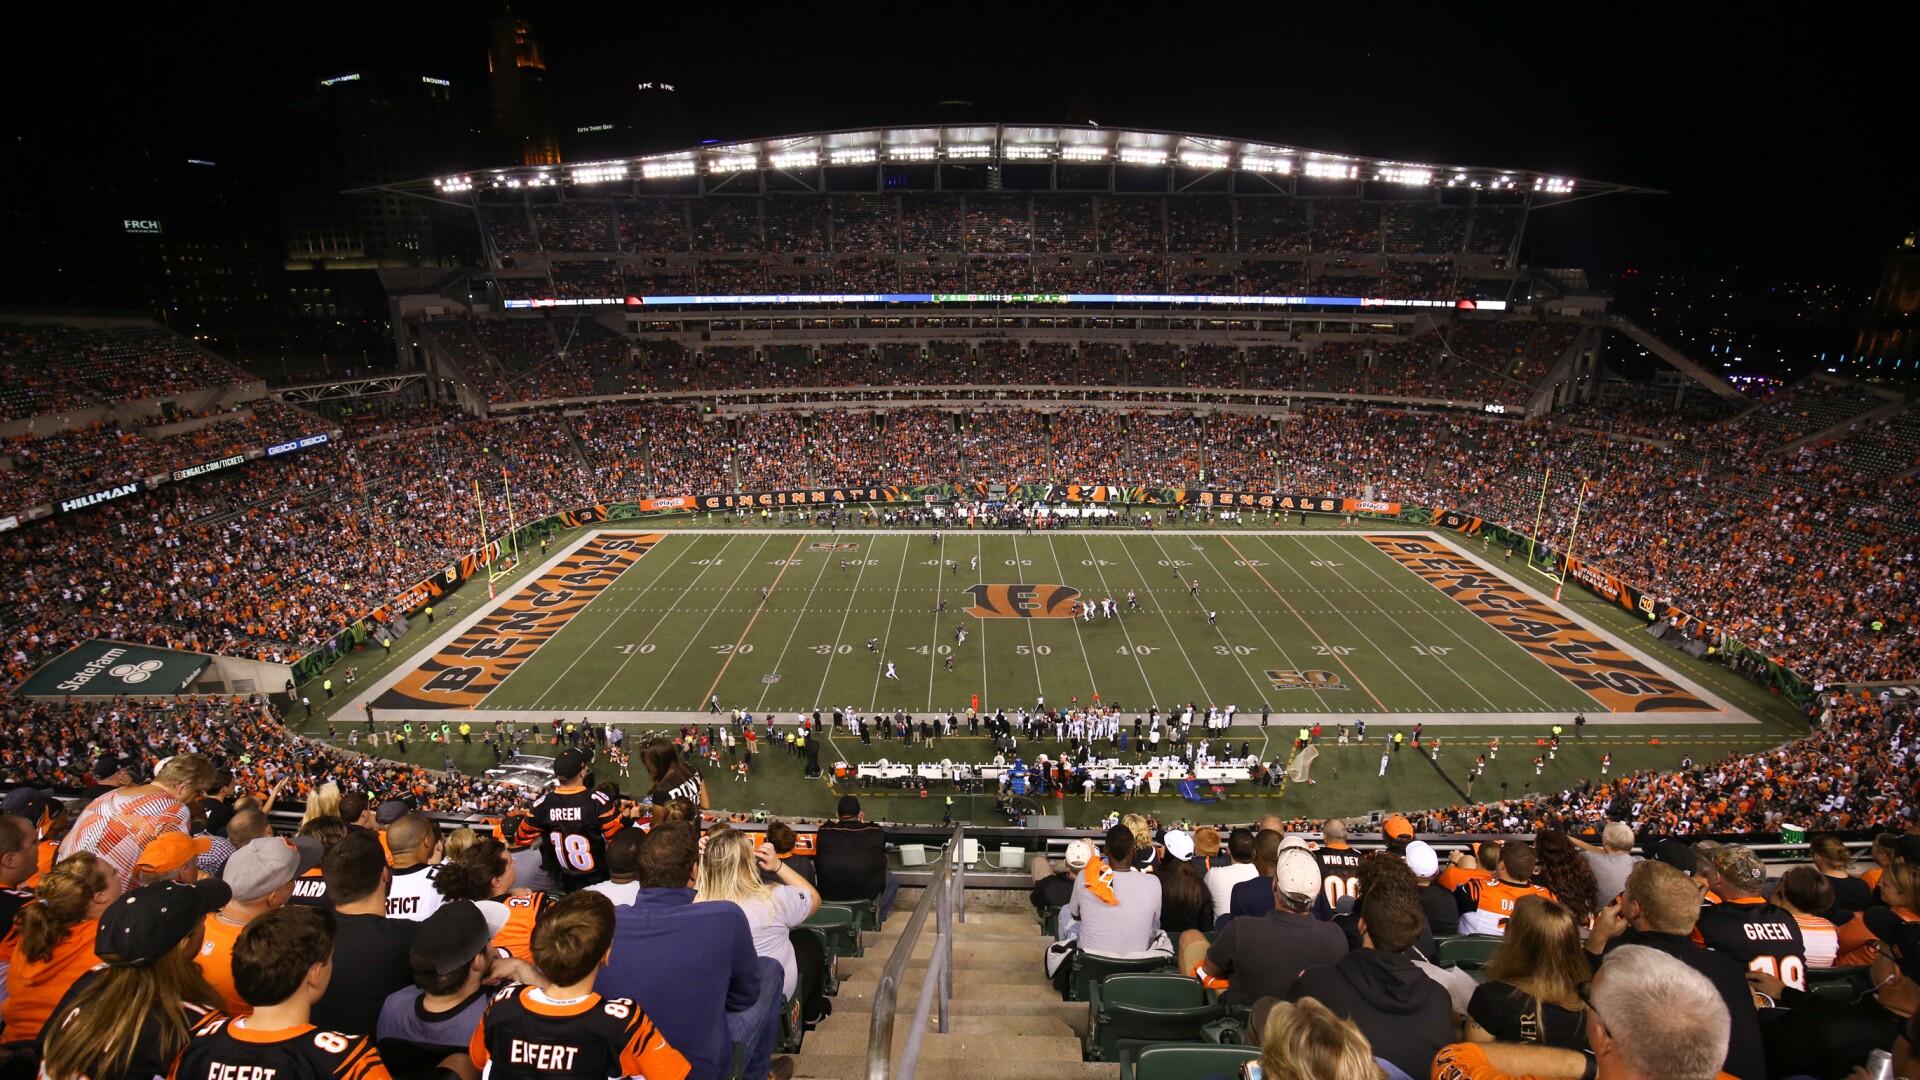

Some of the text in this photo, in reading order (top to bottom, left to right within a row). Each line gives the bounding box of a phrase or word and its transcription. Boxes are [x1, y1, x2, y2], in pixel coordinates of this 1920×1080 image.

[124, 220, 158, 229] FRCH
[268, 434, 328, 455] GEICO GEICO
[173, 455, 244, 481] BENGALS.COM/TICKETS
[62, 484, 138, 512] HILLMAN
[706, 489, 878, 508] CINCINNATI
[1200, 492, 1334, 511] BENGALS
[1581, 567, 1609, 584] TICKETS
[419, 538, 638, 693] BENGALS
[1391, 541, 1663, 696] BENGALS
[619, 644, 656, 654] 10
[716, 644, 754, 654] 20
[815, 644, 852, 654] 30
[915, 644, 951, 654] 40
[1016, 645, 1051, 655] 50
[1116, 645, 1151, 655] 40
[1213, 645, 1251, 655] 30
[1311, 645, 1349, 655] 20
[1410, 645, 1447, 655] 10
[56, 648, 128, 691] StateFarm
[549, 807, 581, 821] GREEN
[550, 831, 595, 872] 18
[1322, 854, 1359, 867] WHO DEY
[293, 880, 326, 898] NARD
[385, 896, 420, 915] RFICT
[1743, 922, 1793, 941] GREEN
[510, 1039, 578, 1071] EIFERT
[207, 1061, 276, 1080] EIFERT
